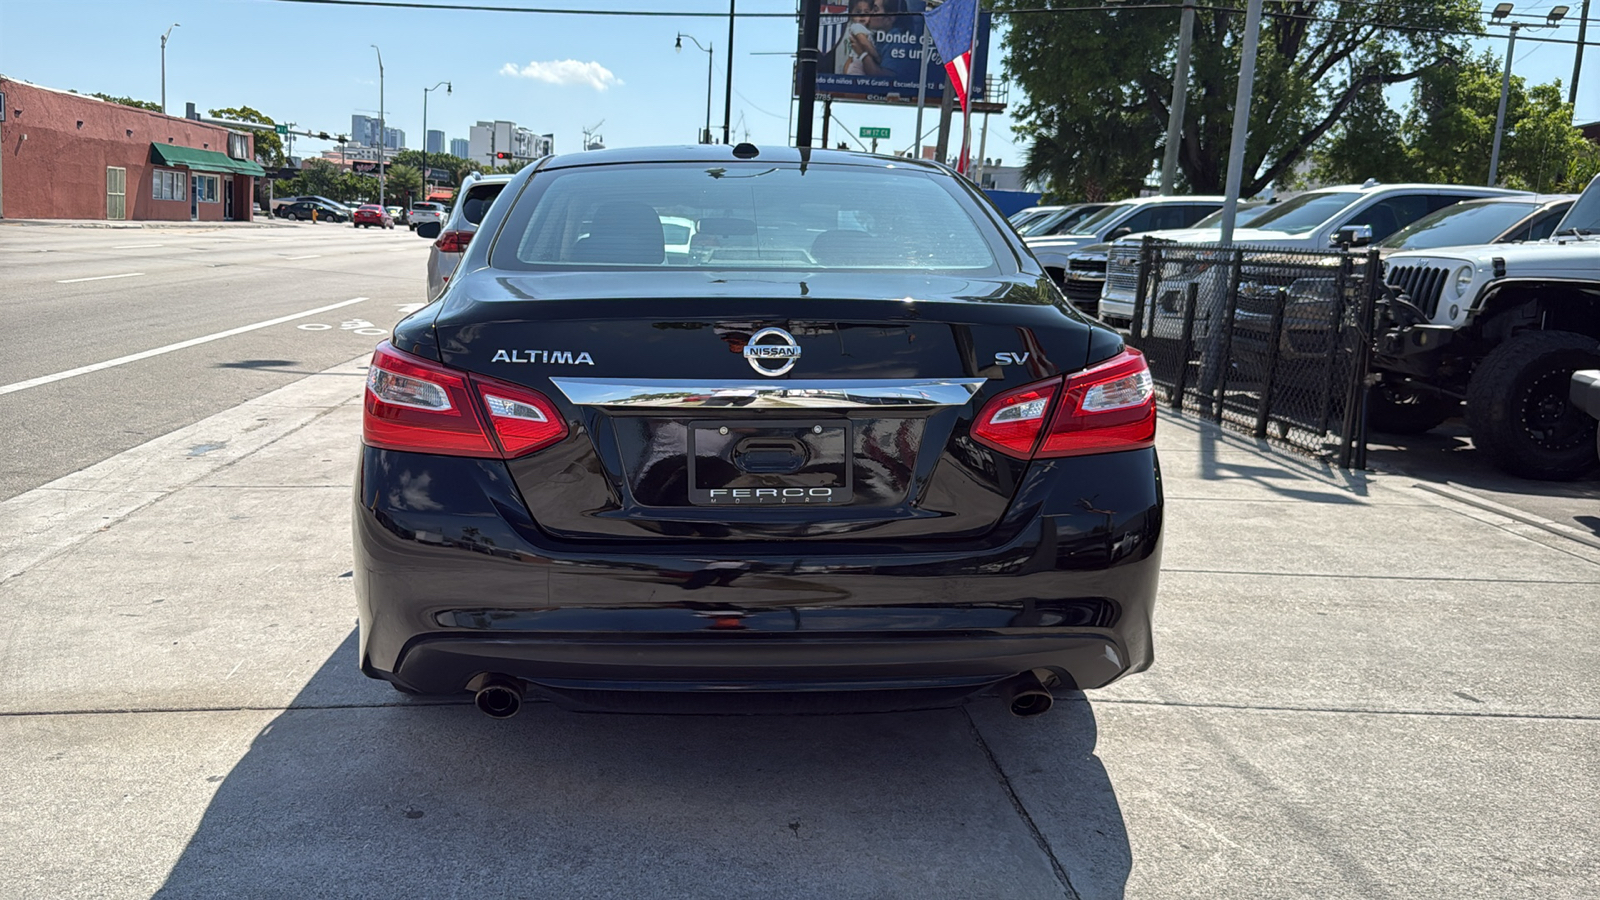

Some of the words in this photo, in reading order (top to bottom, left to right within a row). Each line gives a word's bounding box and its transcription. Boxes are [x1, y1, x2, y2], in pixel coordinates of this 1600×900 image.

[876, 31, 916, 44] Donde
[891, 49, 905, 58] es
[871, 79, 889, 87] Gratis
[880, 129, 889, 137] Ct
[749, 347, 795, 356] NISSAN
[491, 349, 595, 366] ALTIMA
[994, 352, 1030, 366] SV
[710, 488, 832, 498] FERCO
